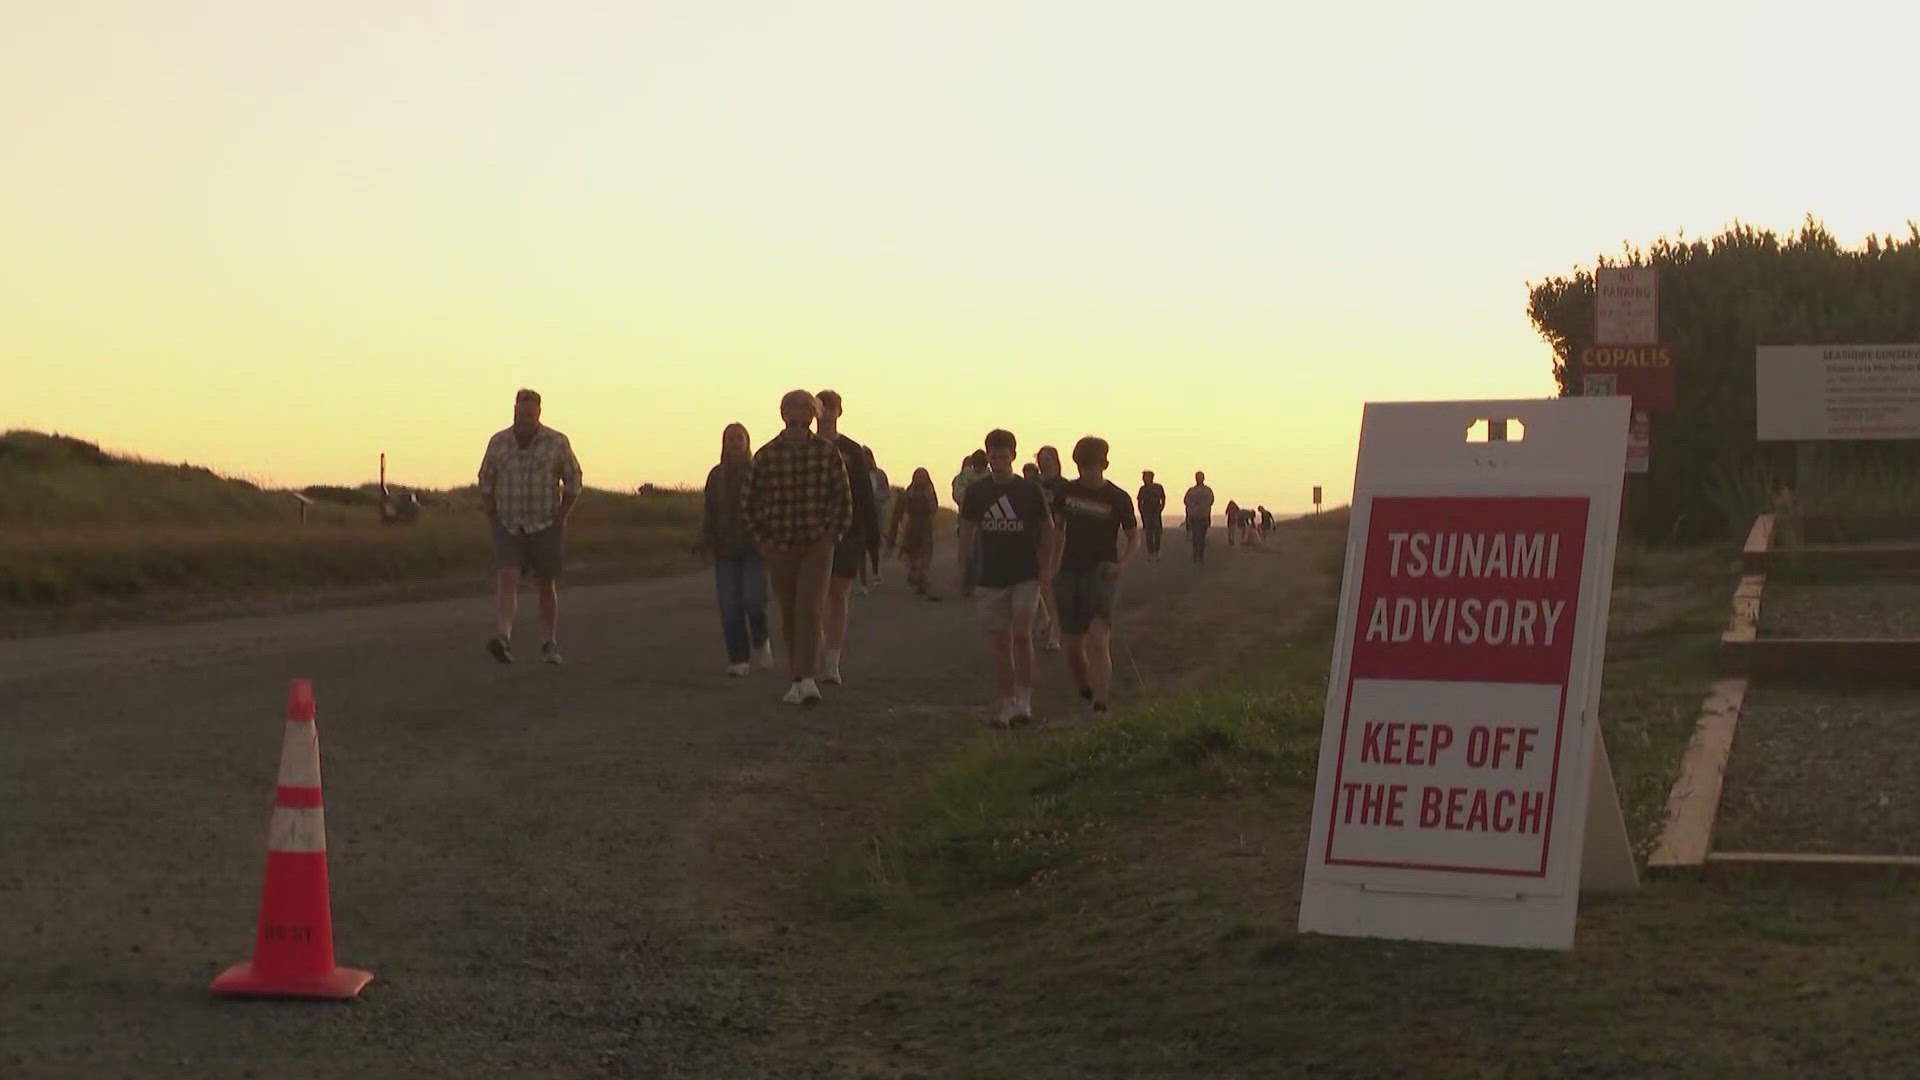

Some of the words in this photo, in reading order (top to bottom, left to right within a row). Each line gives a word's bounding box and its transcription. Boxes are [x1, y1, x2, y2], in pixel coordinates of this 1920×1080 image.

[1602, 286, 1650, 298] PARKING
[1583, 348, 1671, 367] COPALIS
[982, 519, 1023, 532] adidas
[1389, 532, 1560, 579] TSUNAMI
[1366, 598, 1565, 645] ADVISORY
[1360, 722, 1453, 766] KEEP
[1467, 727, 1539, 770] OFF
[1343, 783, 1407, 827] THE
[1419, 786, 1543, 834] BEACH
